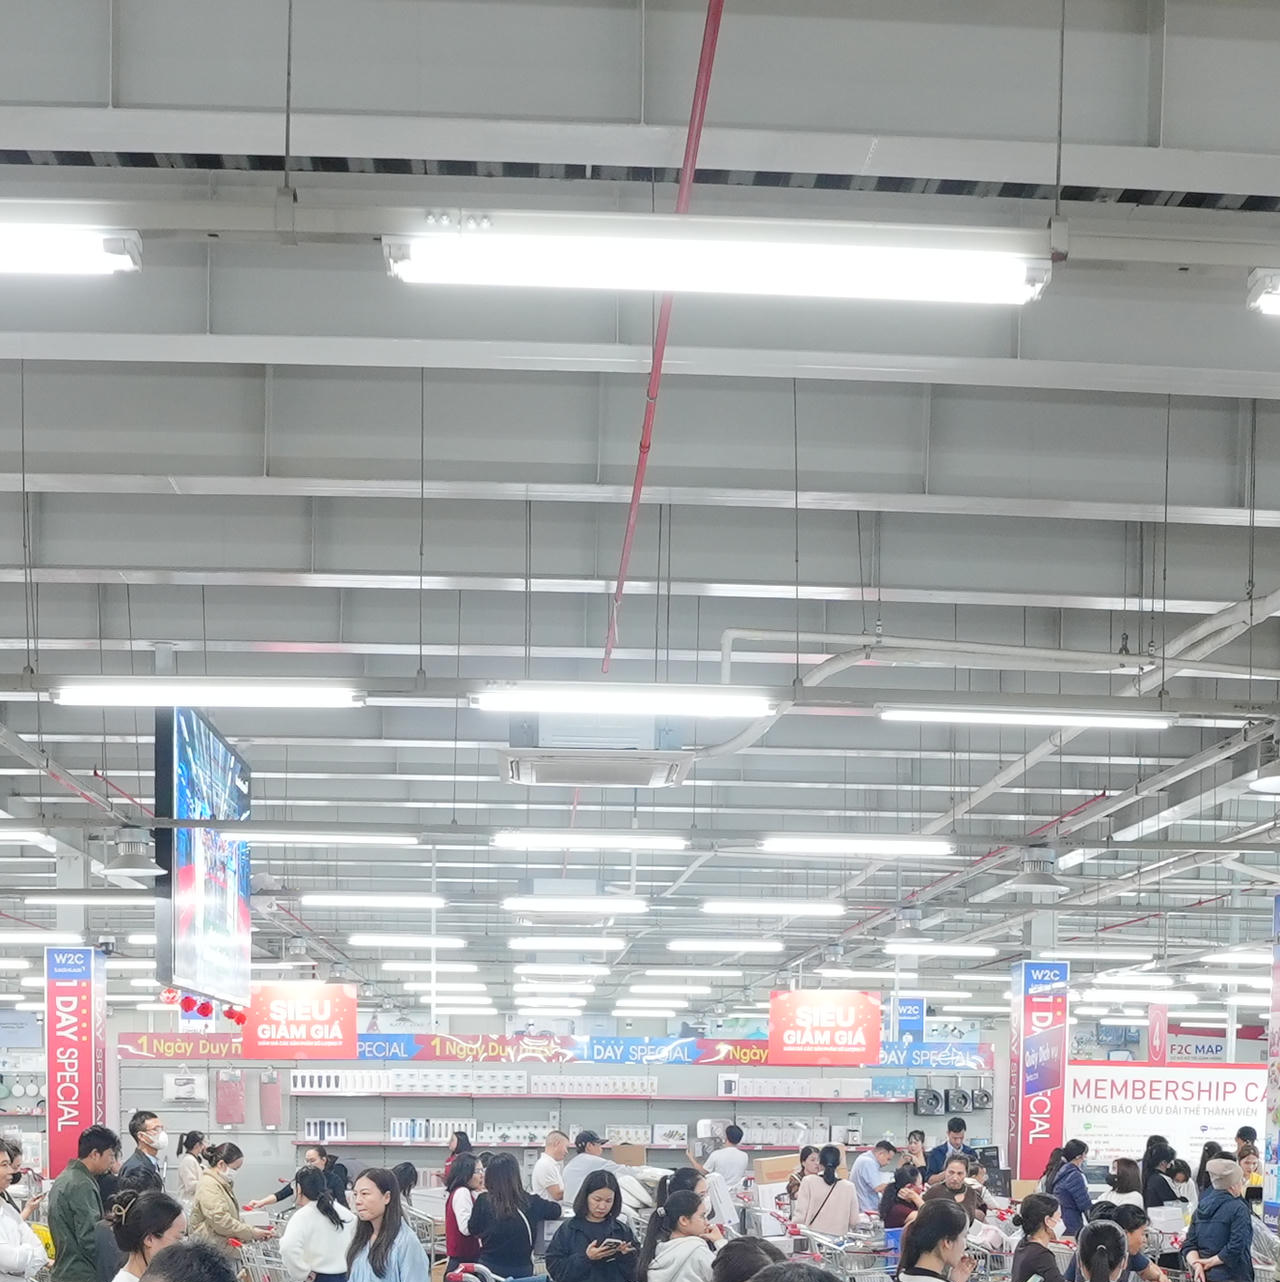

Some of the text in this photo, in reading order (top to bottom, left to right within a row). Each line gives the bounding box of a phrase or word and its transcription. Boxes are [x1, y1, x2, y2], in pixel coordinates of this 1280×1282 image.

[54, 953, 85, 964] W2C
[1031, 969, 1060, 981] W2C
[55, 996, 79, 1042] DAY
[898, 1006, 920, 1015] W2C
[310, 1019, 343, 1040] GIÁ
[834, 1027, 866, 1046] GIÁ
[137, 1035, 148, 1055] 1
[153, 1038, 193, 1057] Ngày
[199, 1039, 229, 1058] Duy
[357, 1041, 408, 1058] PECIAL
[431, 1036, 441, 1056] 1
[593, 1044, 625, 1061] DAY
[729, 1045, 769, 1063] Ngày
[1170, 1043, 1223, 1055] F2C MAP
[56, 1047, 80, 1132] SPECIAL
[1072, 1078, 1237, 1101] MEMBERSHIP
[1071, 1103, 1109, 1114] THÔNG
[1111, 1103, 1133, 1115] BÁO
